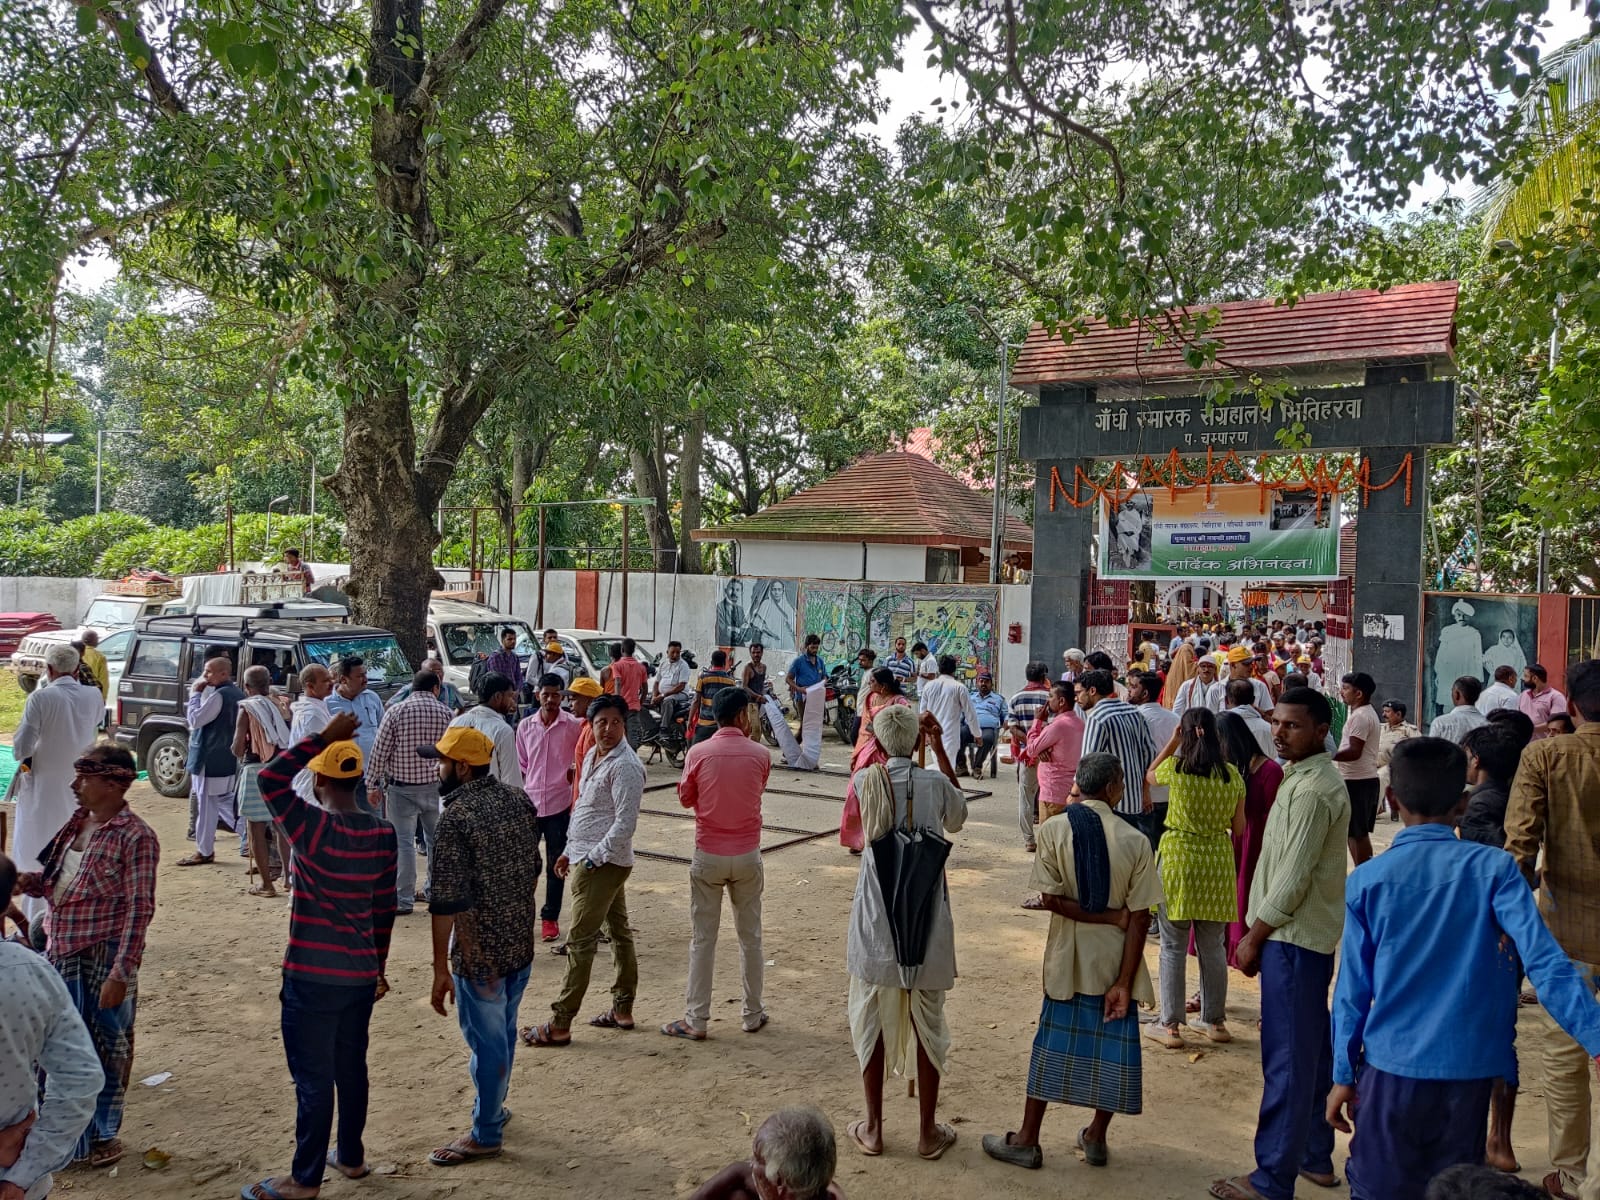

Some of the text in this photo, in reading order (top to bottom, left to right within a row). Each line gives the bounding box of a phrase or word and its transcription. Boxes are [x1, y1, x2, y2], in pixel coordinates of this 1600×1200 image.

[1137, 408, 1191, 429] स्मारक
[1200, 432, 1248, 445] चम्पारण
[1167, 555, 1313, 570] हार्दिक अभिनंदन!
